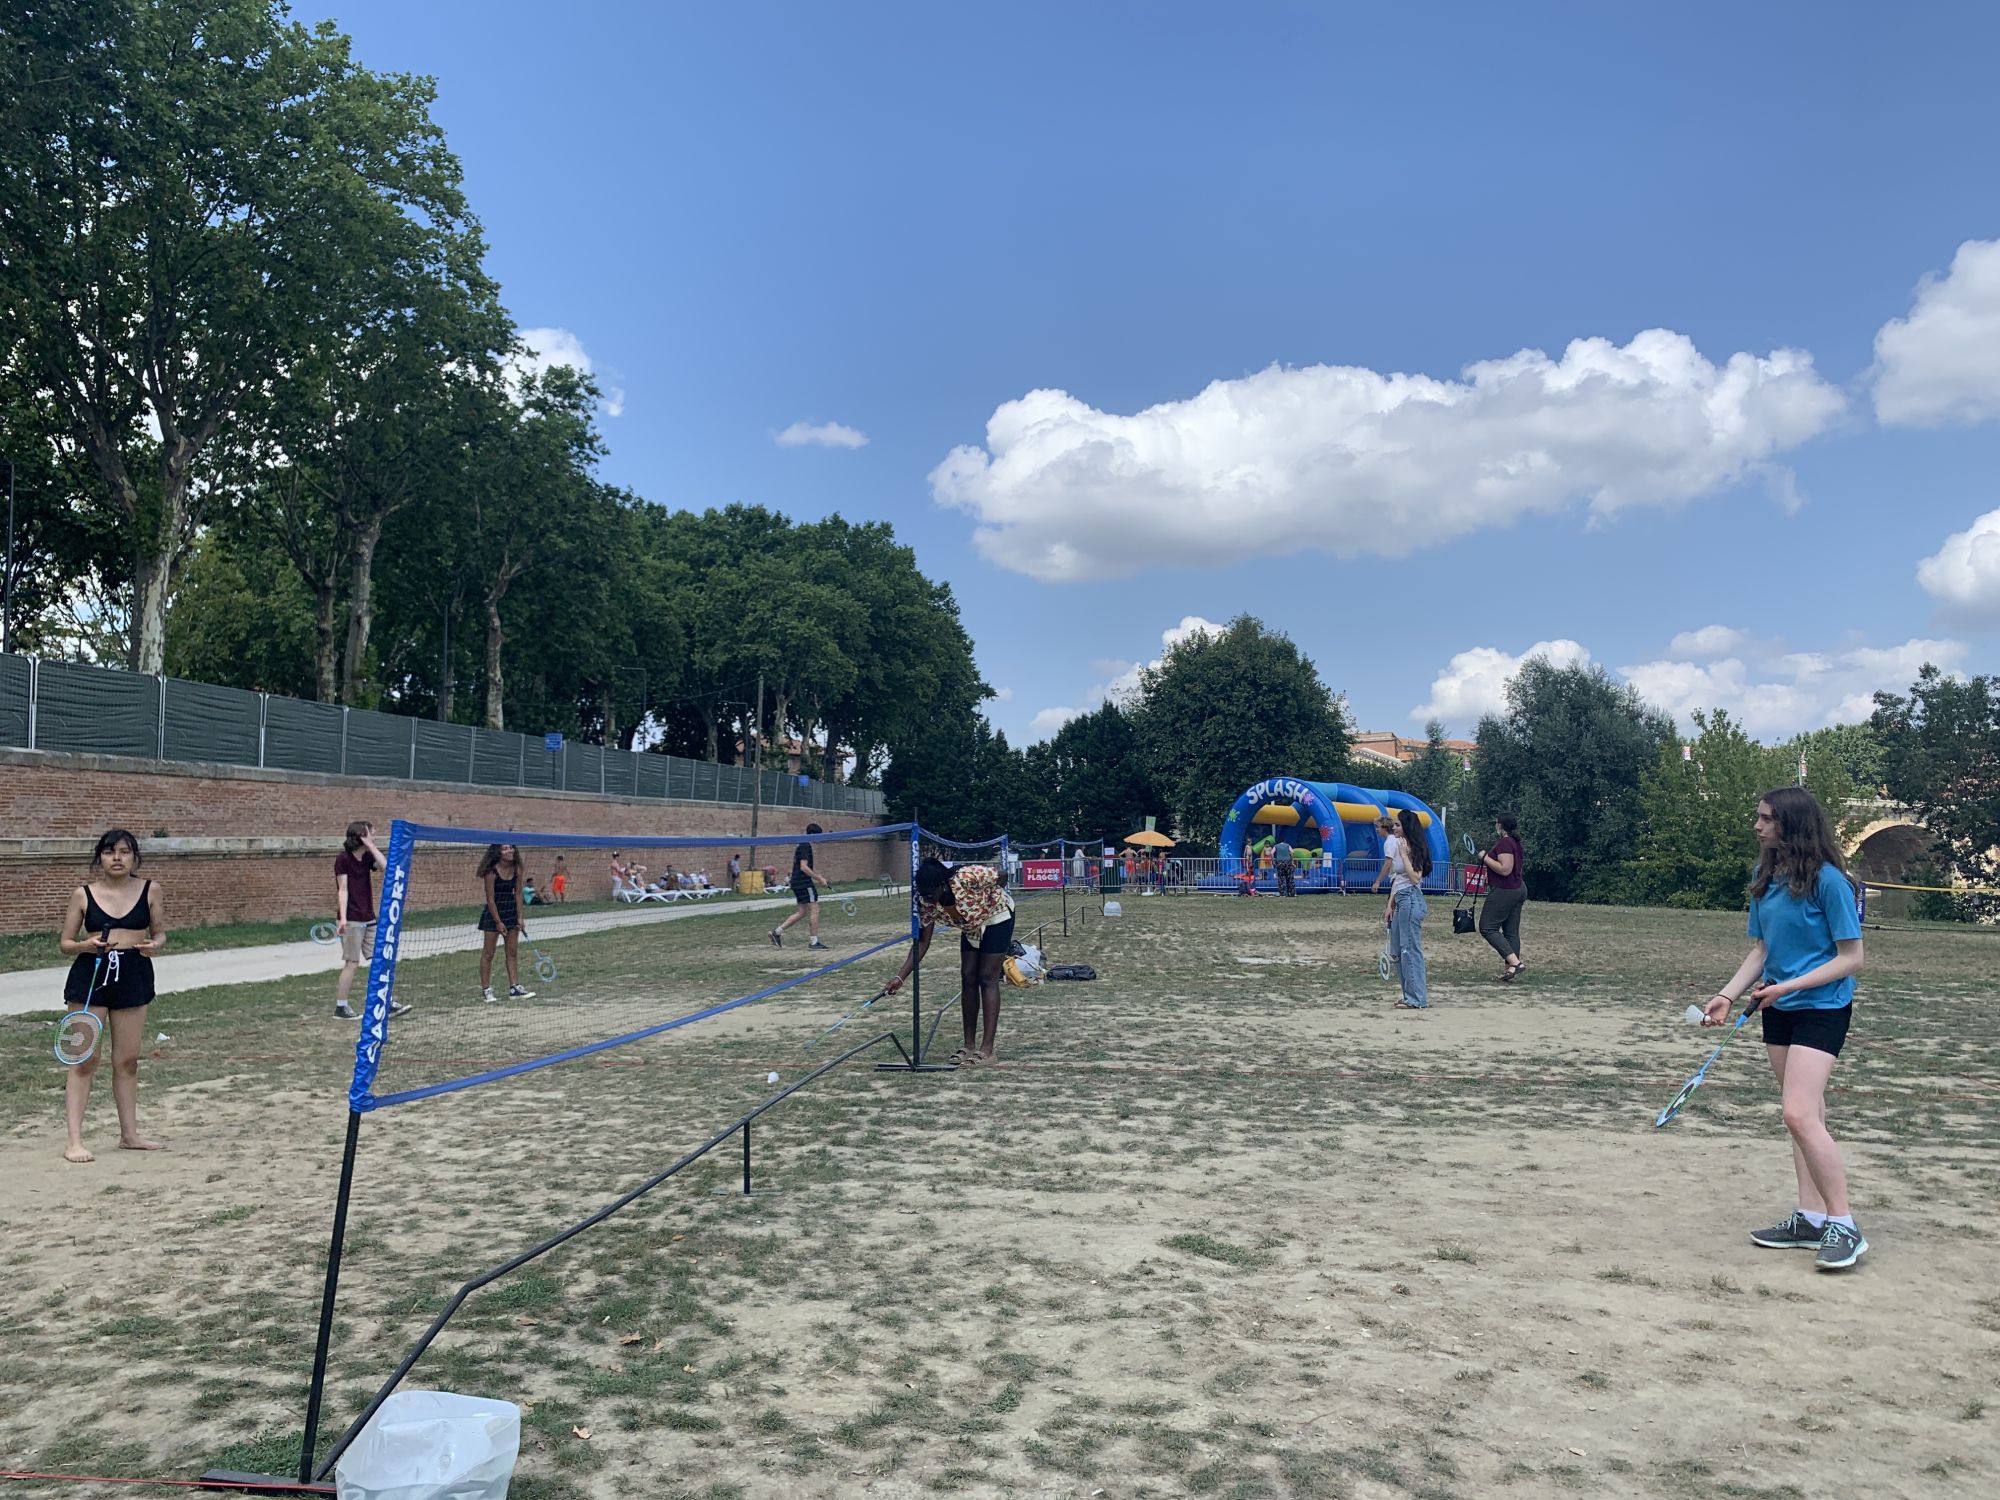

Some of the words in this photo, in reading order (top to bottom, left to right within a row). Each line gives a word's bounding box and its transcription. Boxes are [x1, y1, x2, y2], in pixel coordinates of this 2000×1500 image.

[1246, 779, 1309, 805] SPLASH
[368, 969, 390, 1063] CASAL
[383, 865, 405, 960] SPORT
